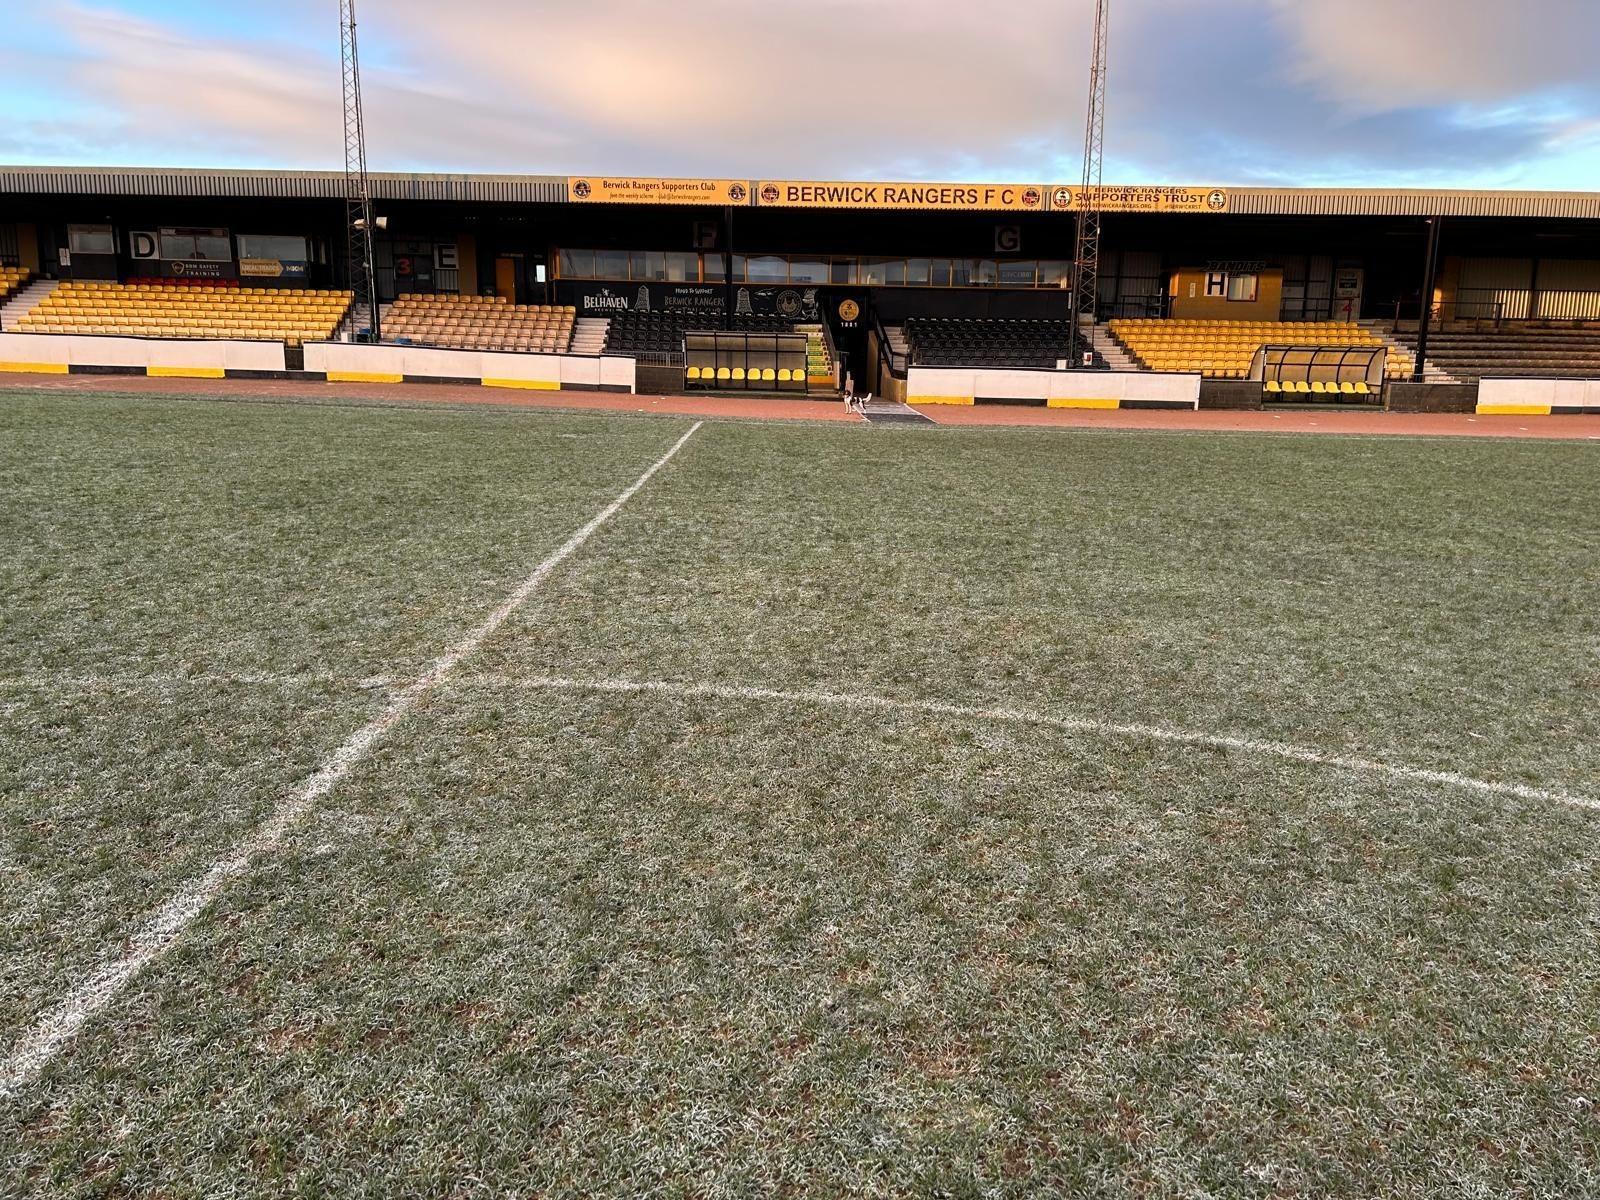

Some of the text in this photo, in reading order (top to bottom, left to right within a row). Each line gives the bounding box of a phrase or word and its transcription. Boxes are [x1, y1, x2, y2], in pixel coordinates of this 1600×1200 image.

[602, 180, 630, 189] Berwick
[632, 181, 660, 191] Rangers
[661, 182, 699, 192] Supporters
[700, 182, 716, 191] Club
[786, 186, 1015, 205] BERWICK RANGERS F C
[1075, 193, 1206, 203] SUPPORTERS TRUST
[132, 232, 155, 258] D
[998, 228, 1018, 250] G
[438, 245, 457, 268] E
[398, 258, 411, 275] 3
[1207, 272, 1226, 296] H
[583, 295, 628, 309] BELHAVEN
[664, 295, 725, 307] BERWICK RANGERS
